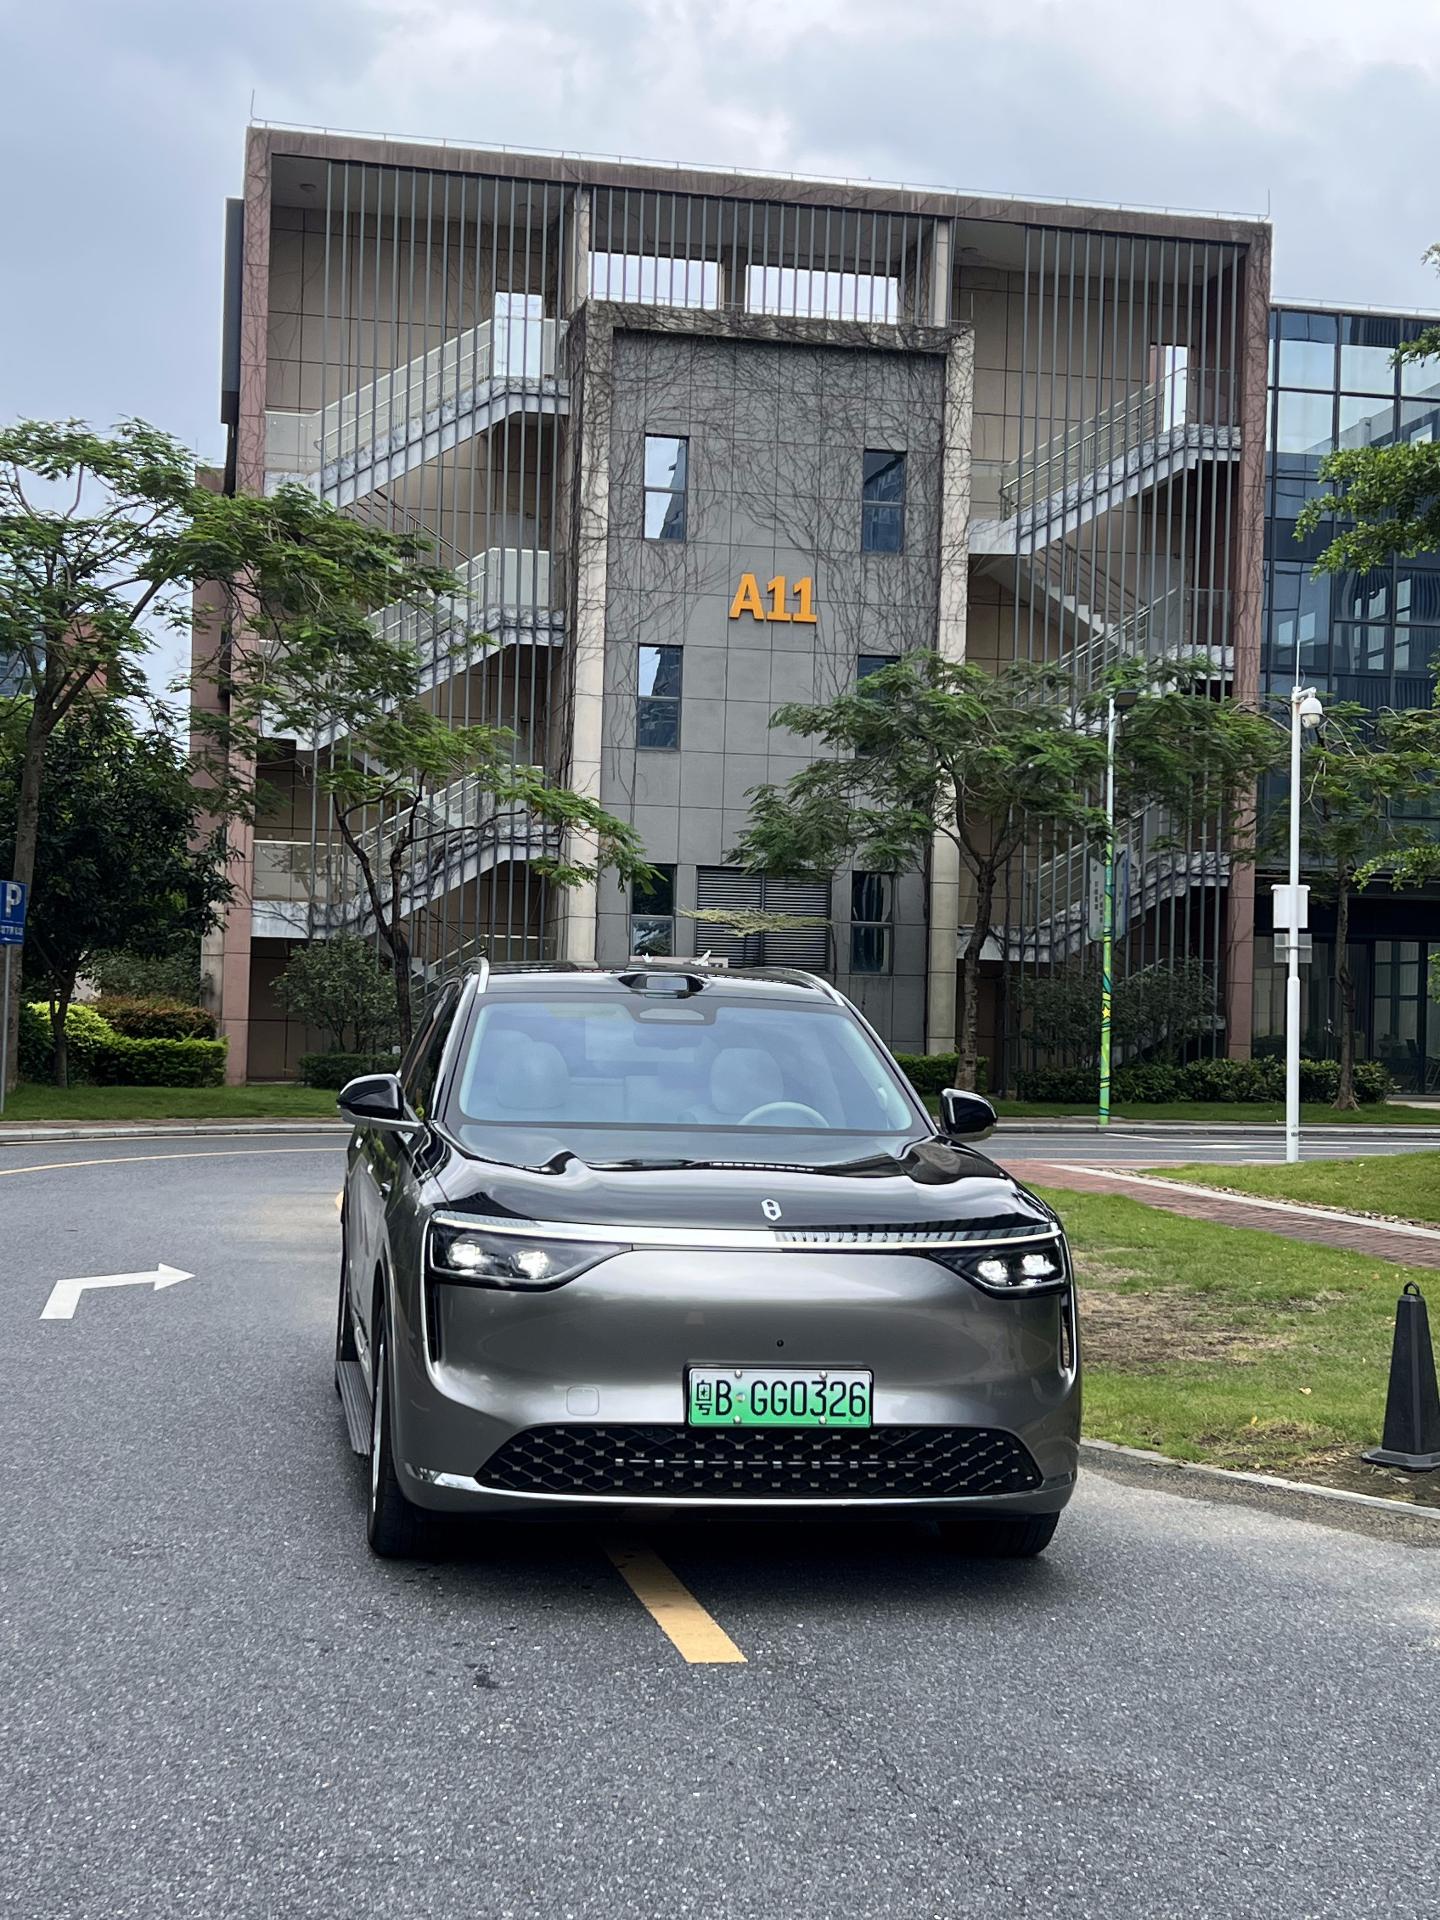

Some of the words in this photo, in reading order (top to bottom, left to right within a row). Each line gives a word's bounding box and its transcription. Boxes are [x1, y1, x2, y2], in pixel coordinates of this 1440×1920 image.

[729, 572, 817, 623] A11
[6, 883, 22, 917] P
[751, 1380, 866, 1418] GG0326
